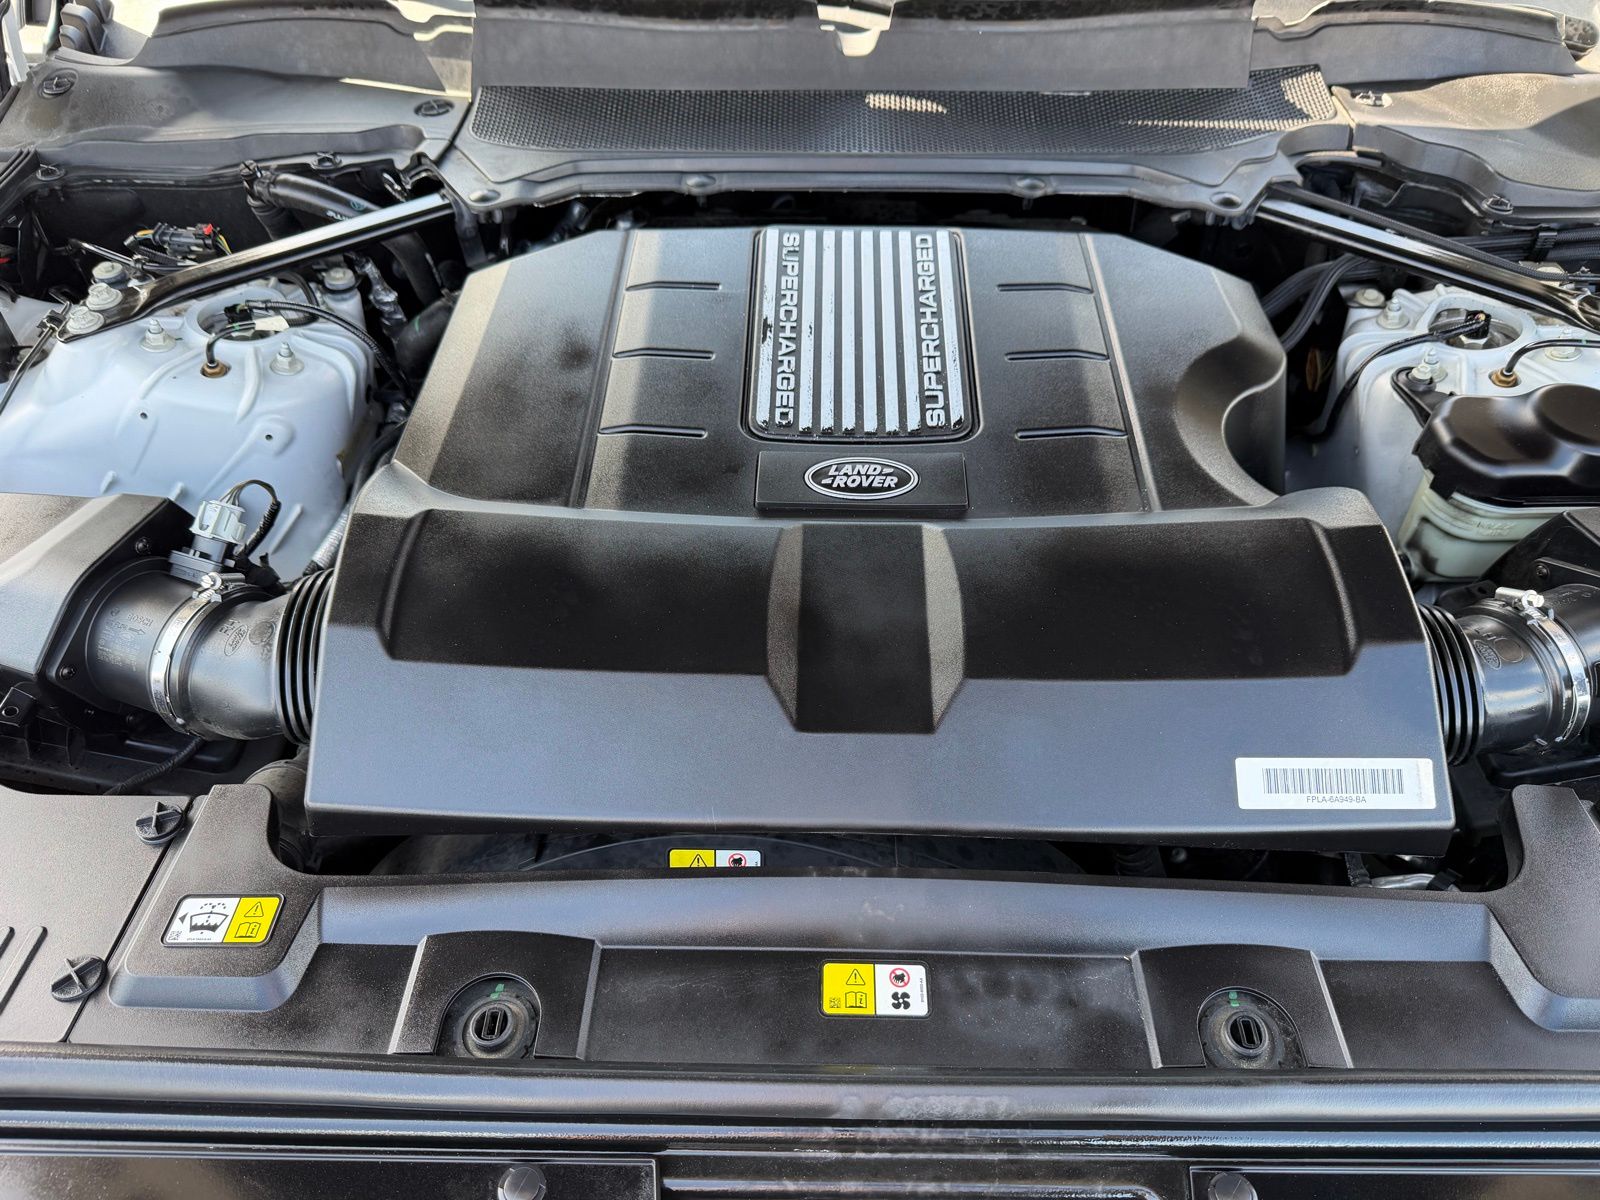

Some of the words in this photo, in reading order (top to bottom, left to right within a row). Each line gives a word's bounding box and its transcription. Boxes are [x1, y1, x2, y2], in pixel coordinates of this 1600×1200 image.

[775, 232, 800, 428] SUPERCHARGED
[915, 233, 946, 428] SUPERCHARGED
[828, 464, 882, 476] LAND
[832, 475, 898, 488] ROVER
[1306, 795, 1367, 804] FPLA-6A949-BA
